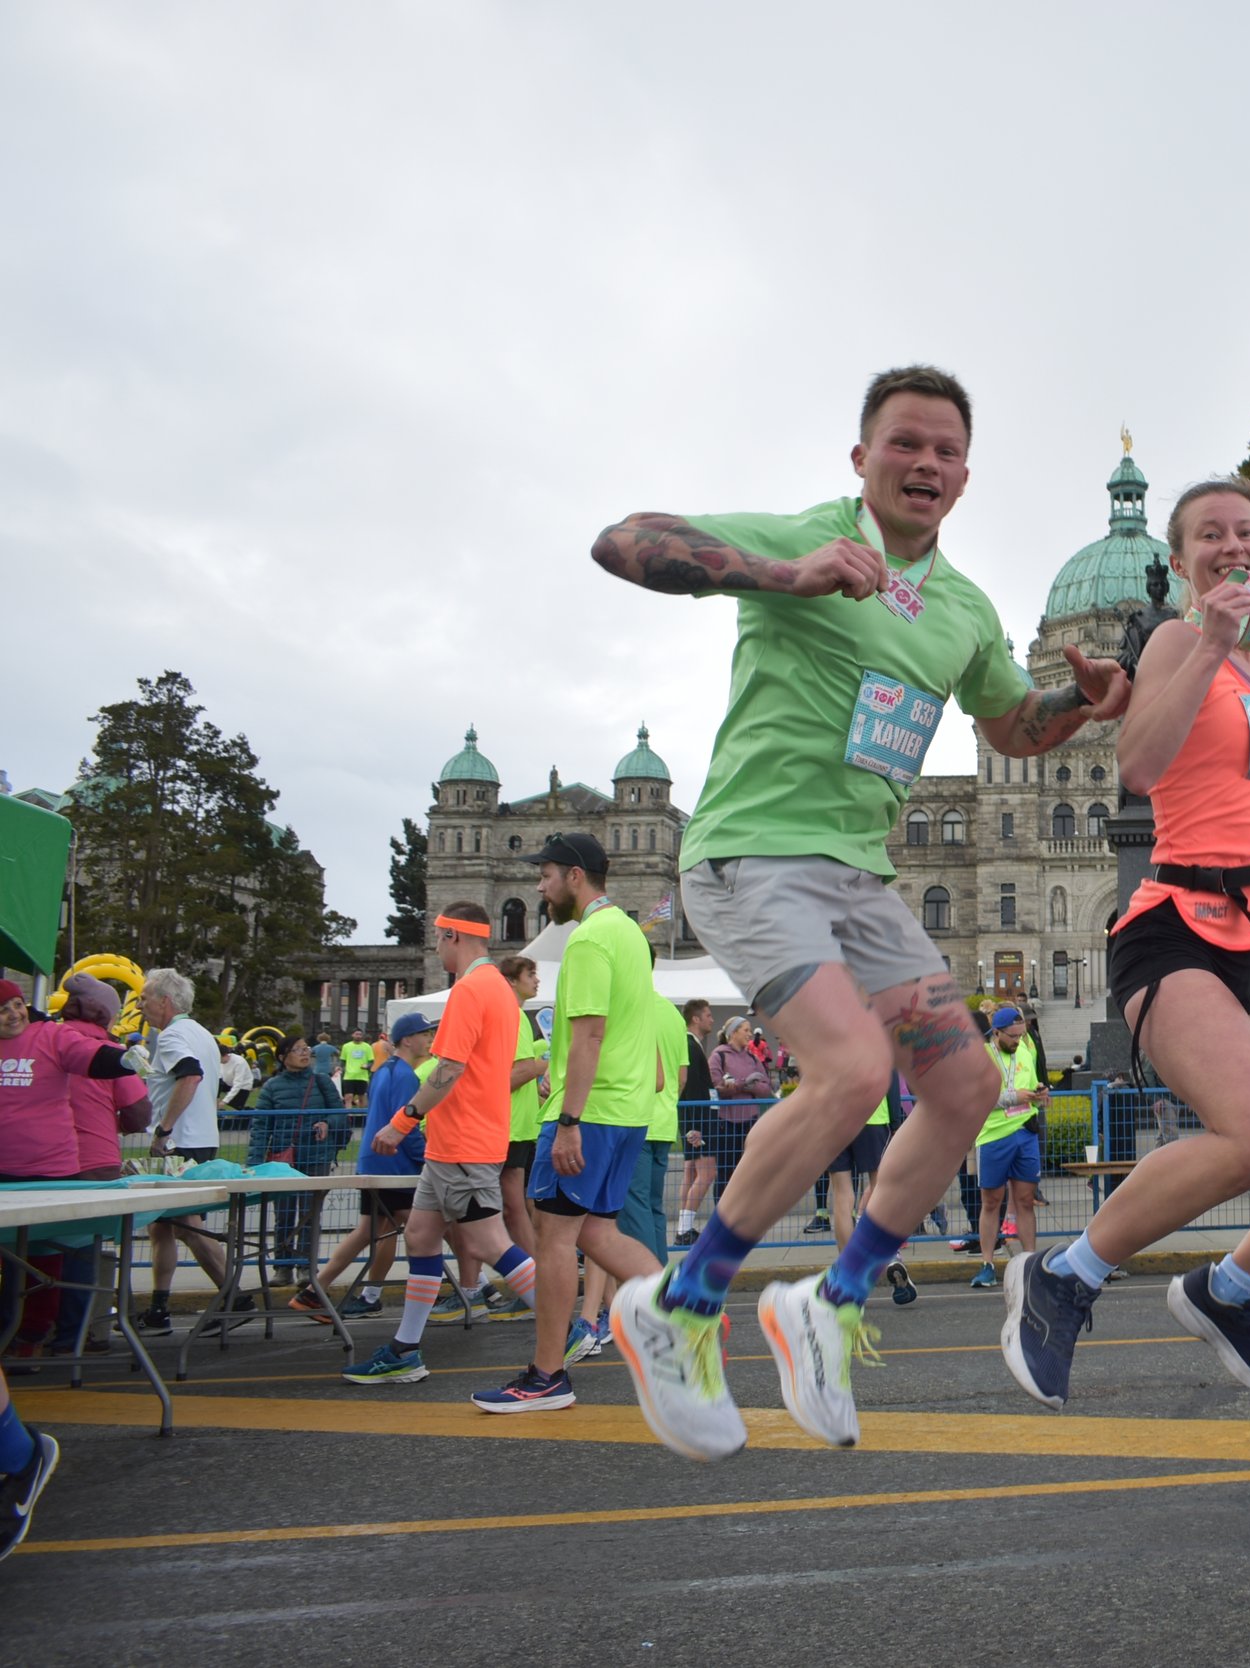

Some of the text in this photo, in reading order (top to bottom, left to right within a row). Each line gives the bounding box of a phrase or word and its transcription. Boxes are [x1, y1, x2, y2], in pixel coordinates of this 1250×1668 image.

[873, 690, 896, 707] 10K
[910, 699, 937, 728] 833
[871, 719, 923, 758] XAVIER
[0, 1058, 36, 1073] 0K
[0, 1078, 33, 1087] REW
